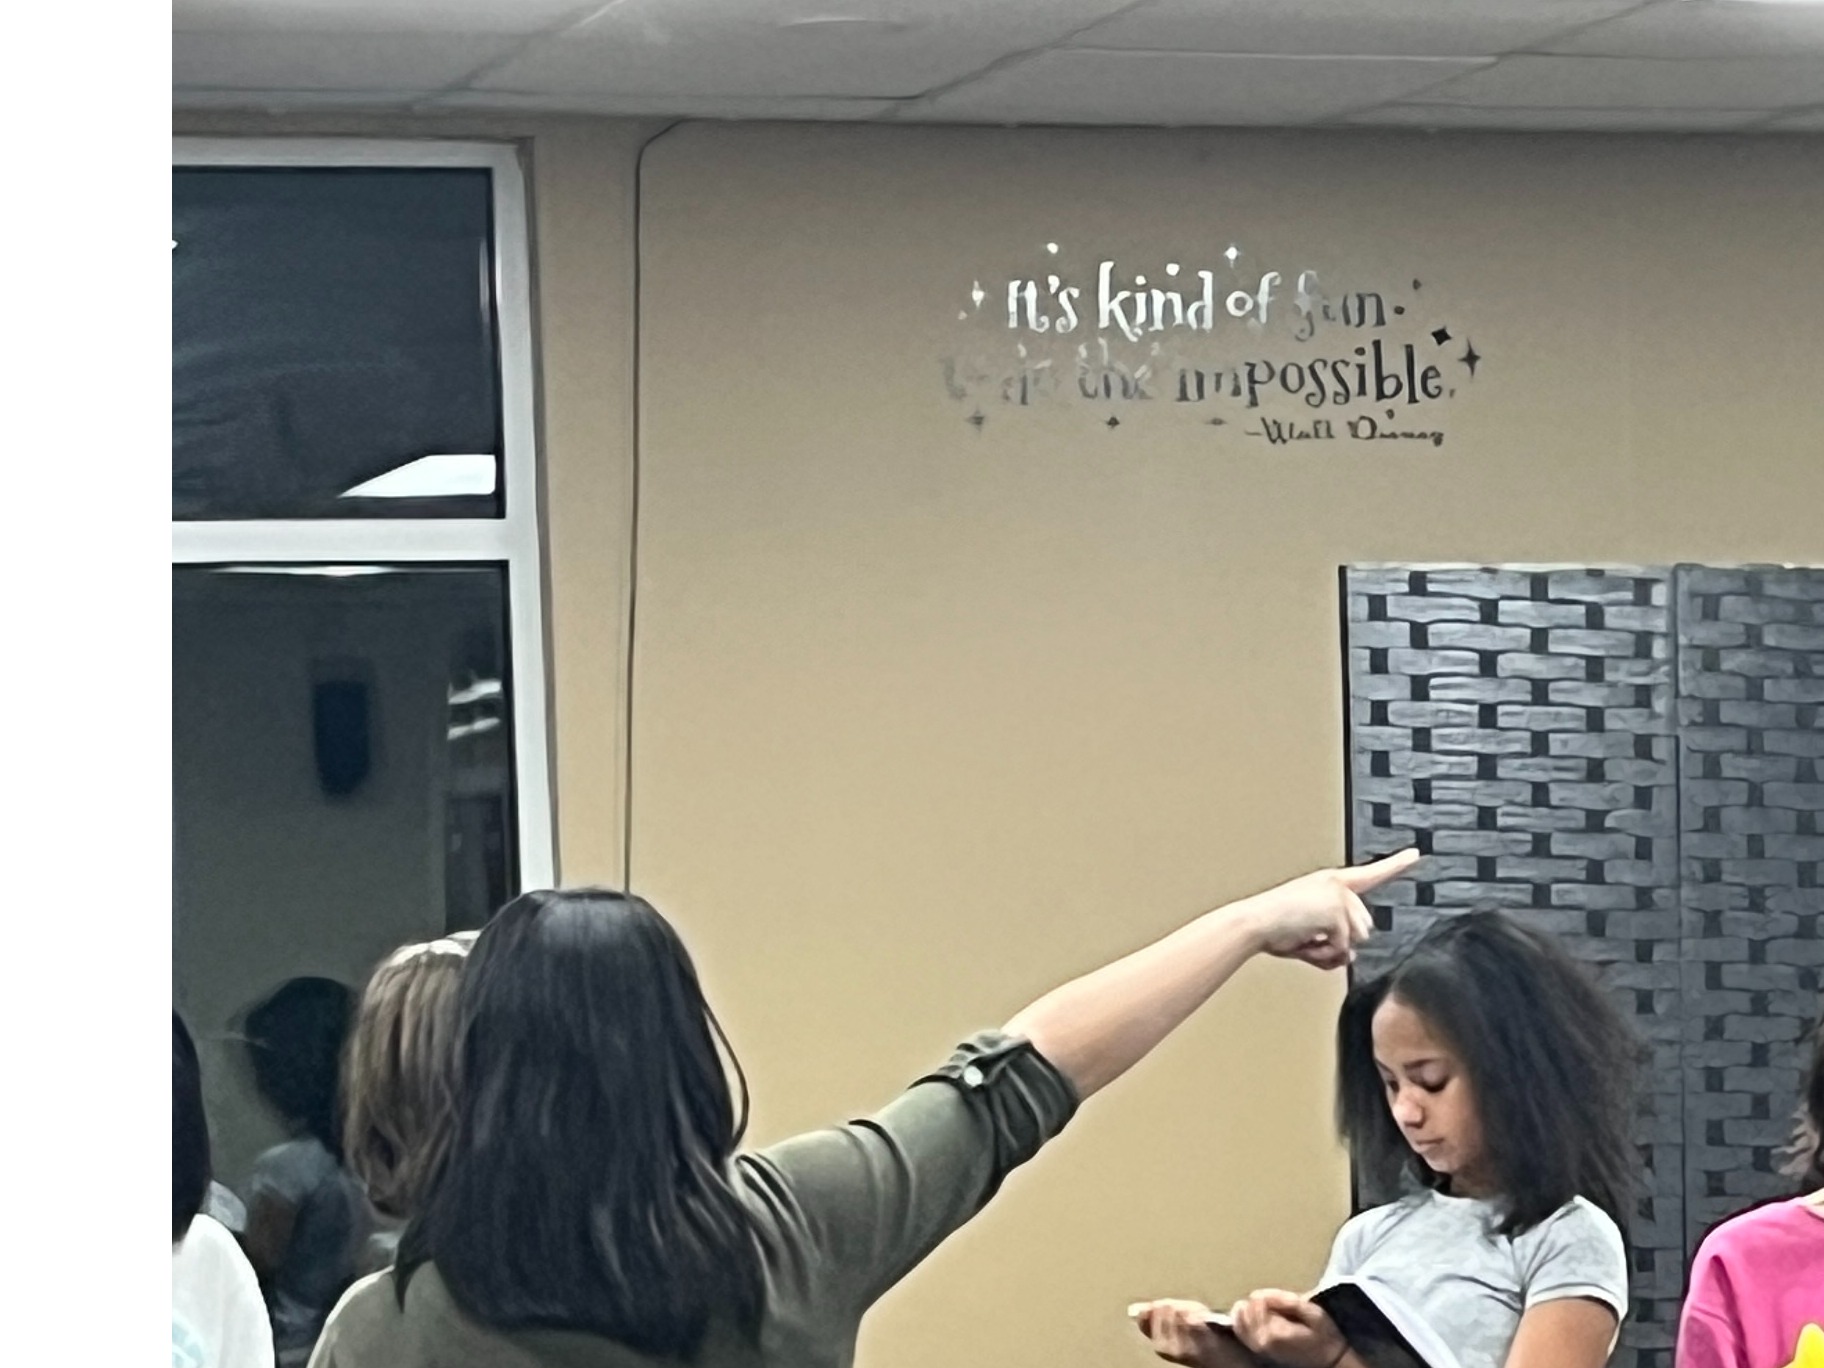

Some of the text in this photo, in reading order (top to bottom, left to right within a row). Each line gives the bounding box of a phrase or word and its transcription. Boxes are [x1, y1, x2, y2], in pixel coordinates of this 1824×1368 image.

[1007, 274, 1079, 334] It's
[1098, 260, 1213, 342] kind
[1225, 270, 1282, 324] of
